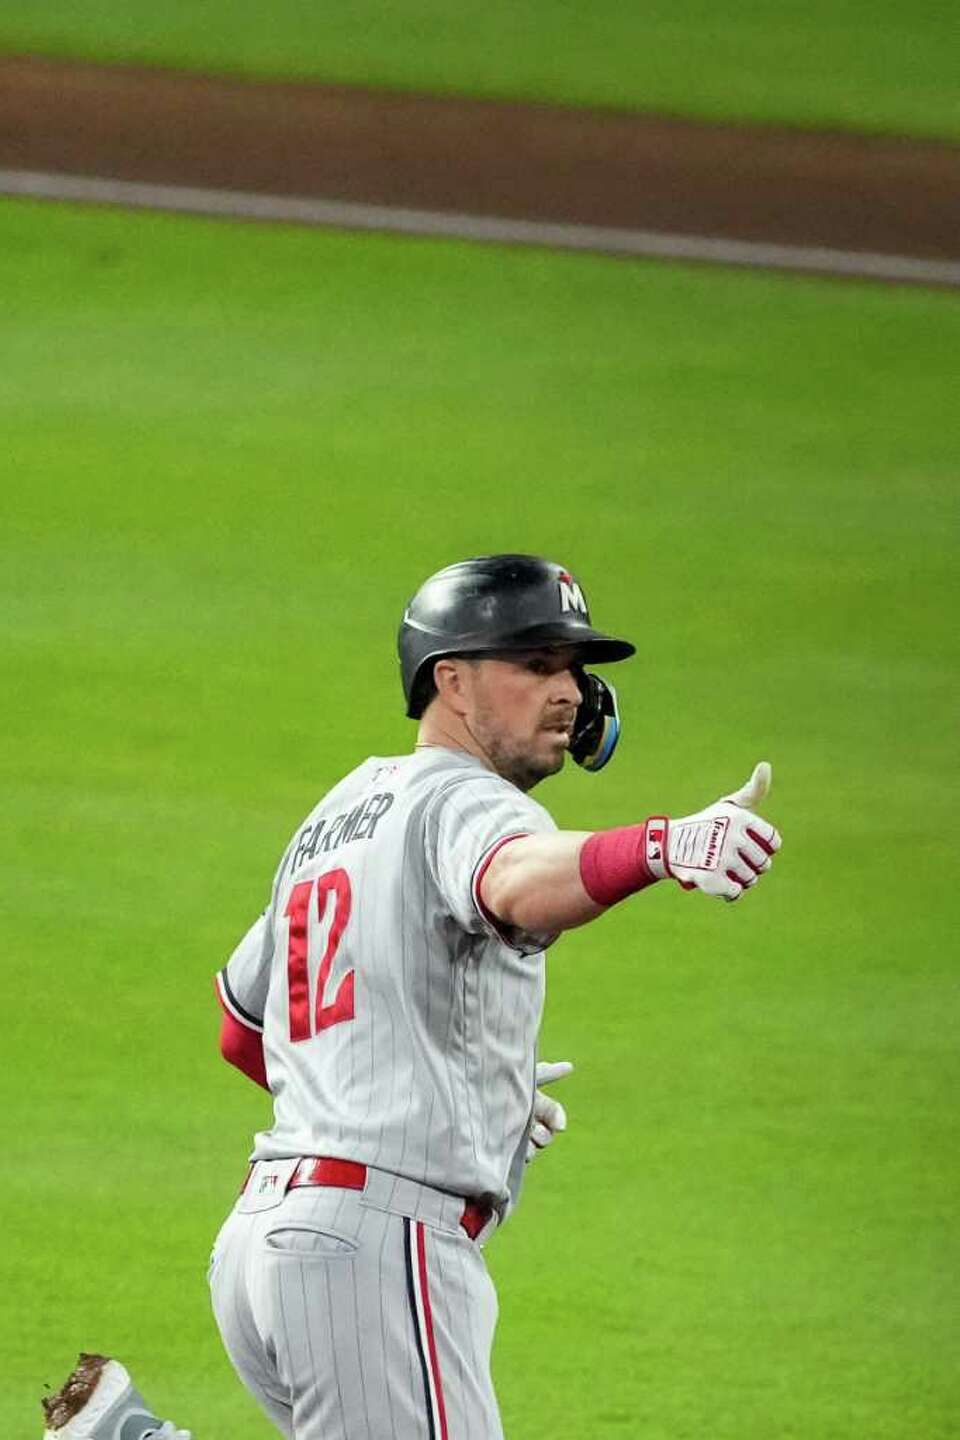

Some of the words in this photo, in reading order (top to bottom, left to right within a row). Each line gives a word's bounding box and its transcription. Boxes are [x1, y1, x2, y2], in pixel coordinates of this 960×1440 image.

[559, 582, 588, 614] M
[290, 792, 395, 874] FARMER
[283, 867, 356, 1043] 12
